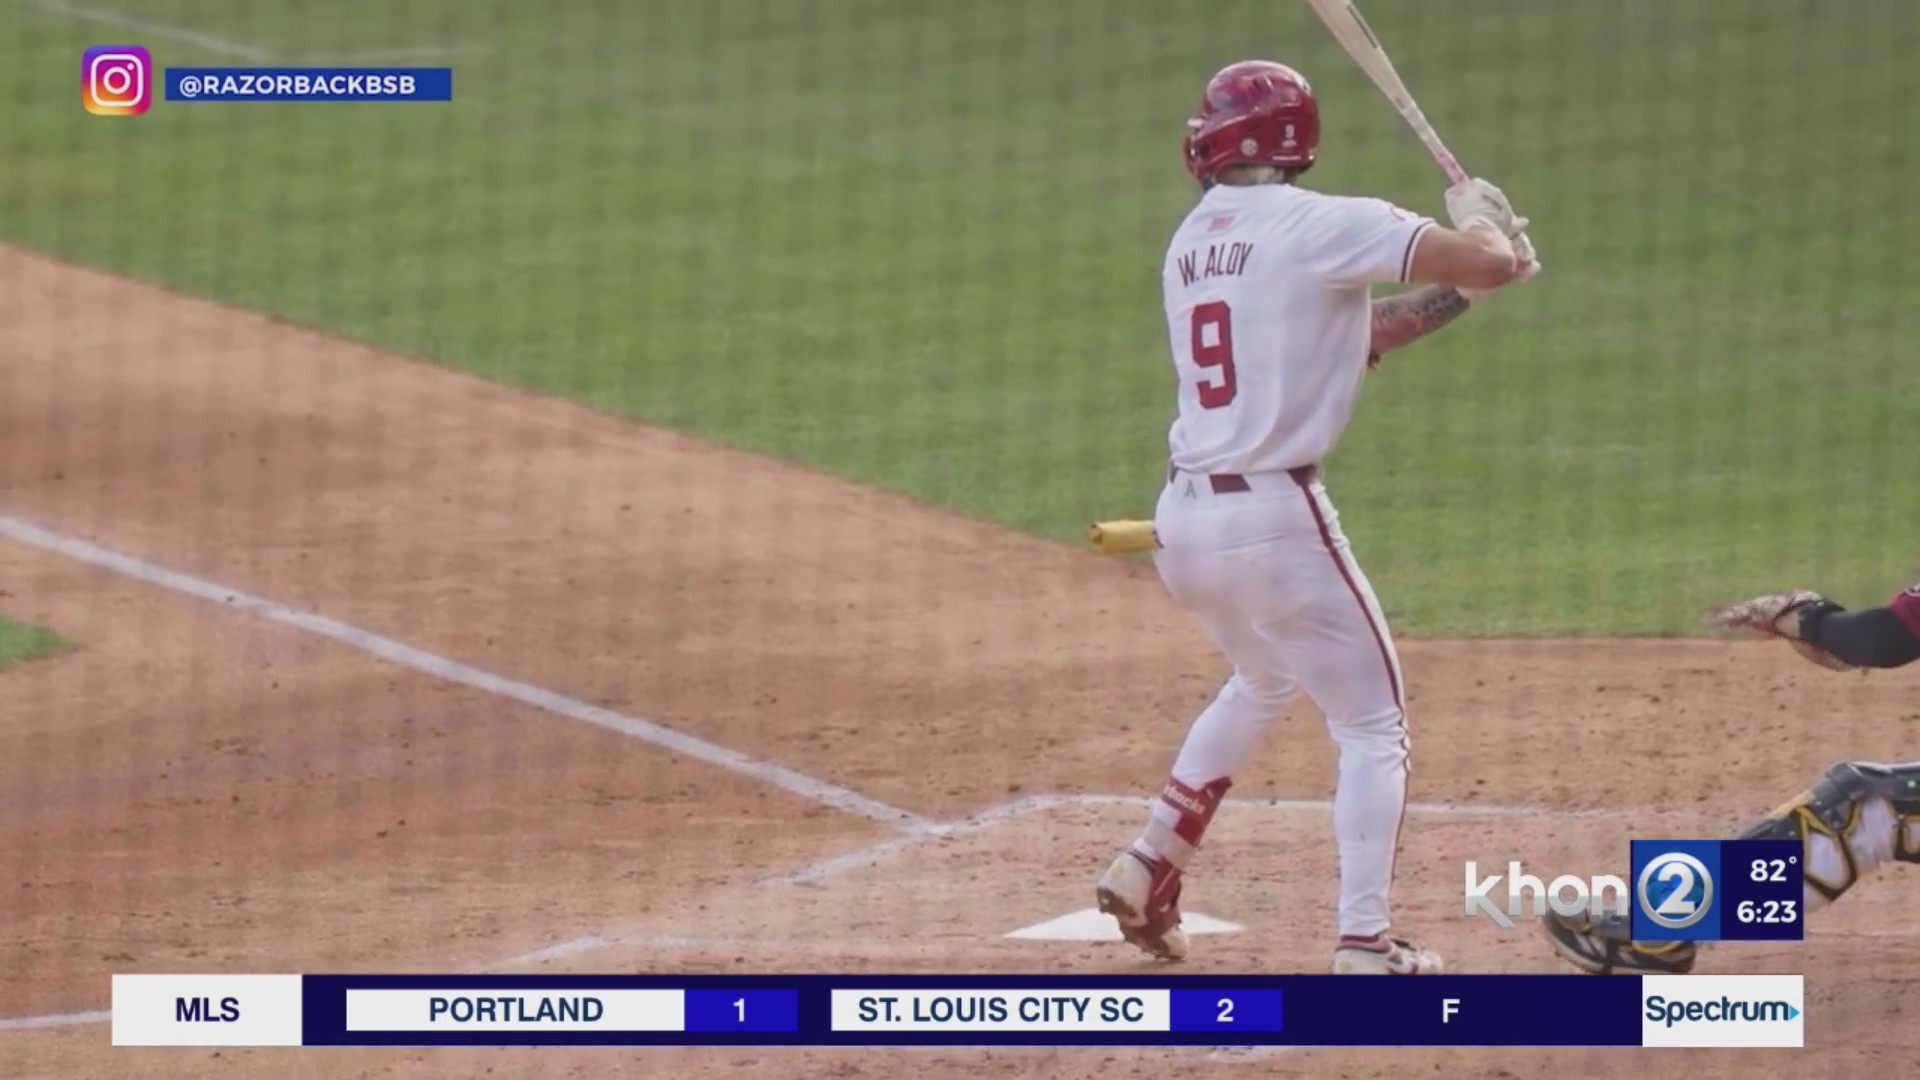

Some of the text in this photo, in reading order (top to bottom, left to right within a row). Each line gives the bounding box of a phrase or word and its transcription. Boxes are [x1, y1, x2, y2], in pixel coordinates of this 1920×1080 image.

[1285, 124, 1296, 139] 9
[1178, 242, 1254, 288] W. ALOY
[1191, 301, 1237, 410] 9
